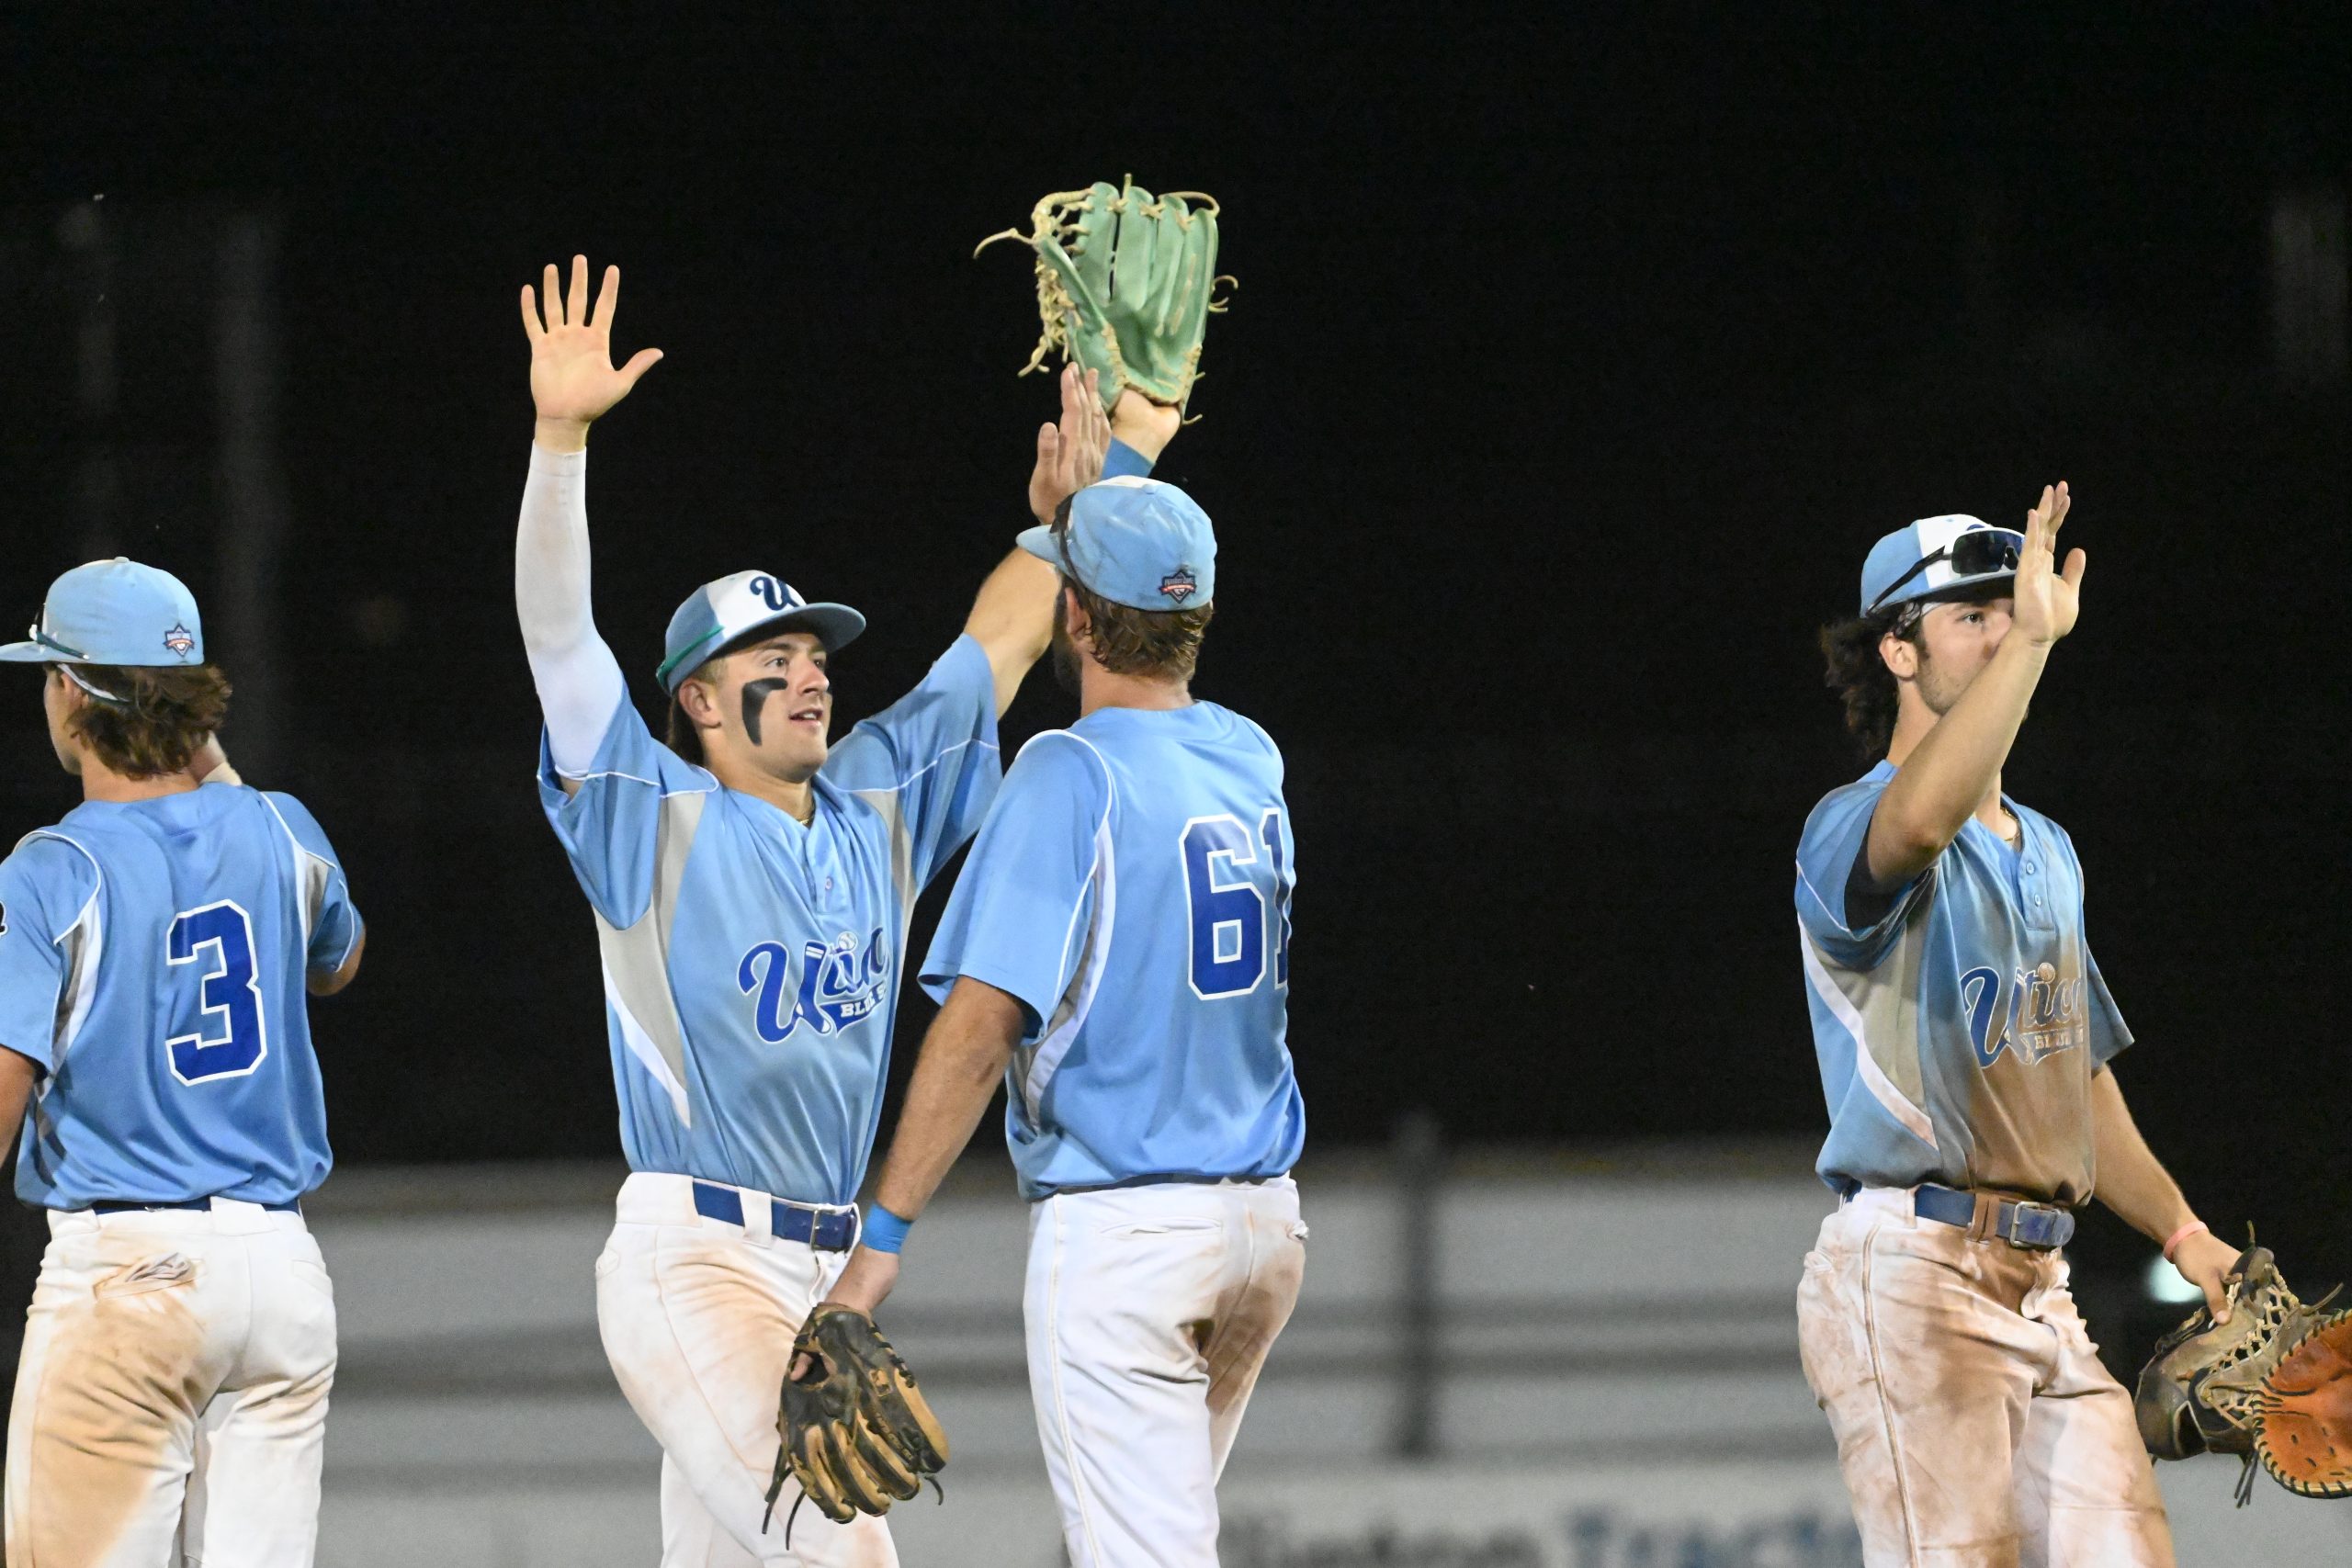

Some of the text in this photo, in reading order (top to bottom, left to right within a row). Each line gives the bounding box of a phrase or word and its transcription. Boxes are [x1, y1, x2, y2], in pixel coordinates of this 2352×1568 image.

[750, 575, 799, 611] U
[1179, 807, 1292, 1000] 61
[165, 898, 267, 1087] 3
[738, 926, 889, 1043] Utic
